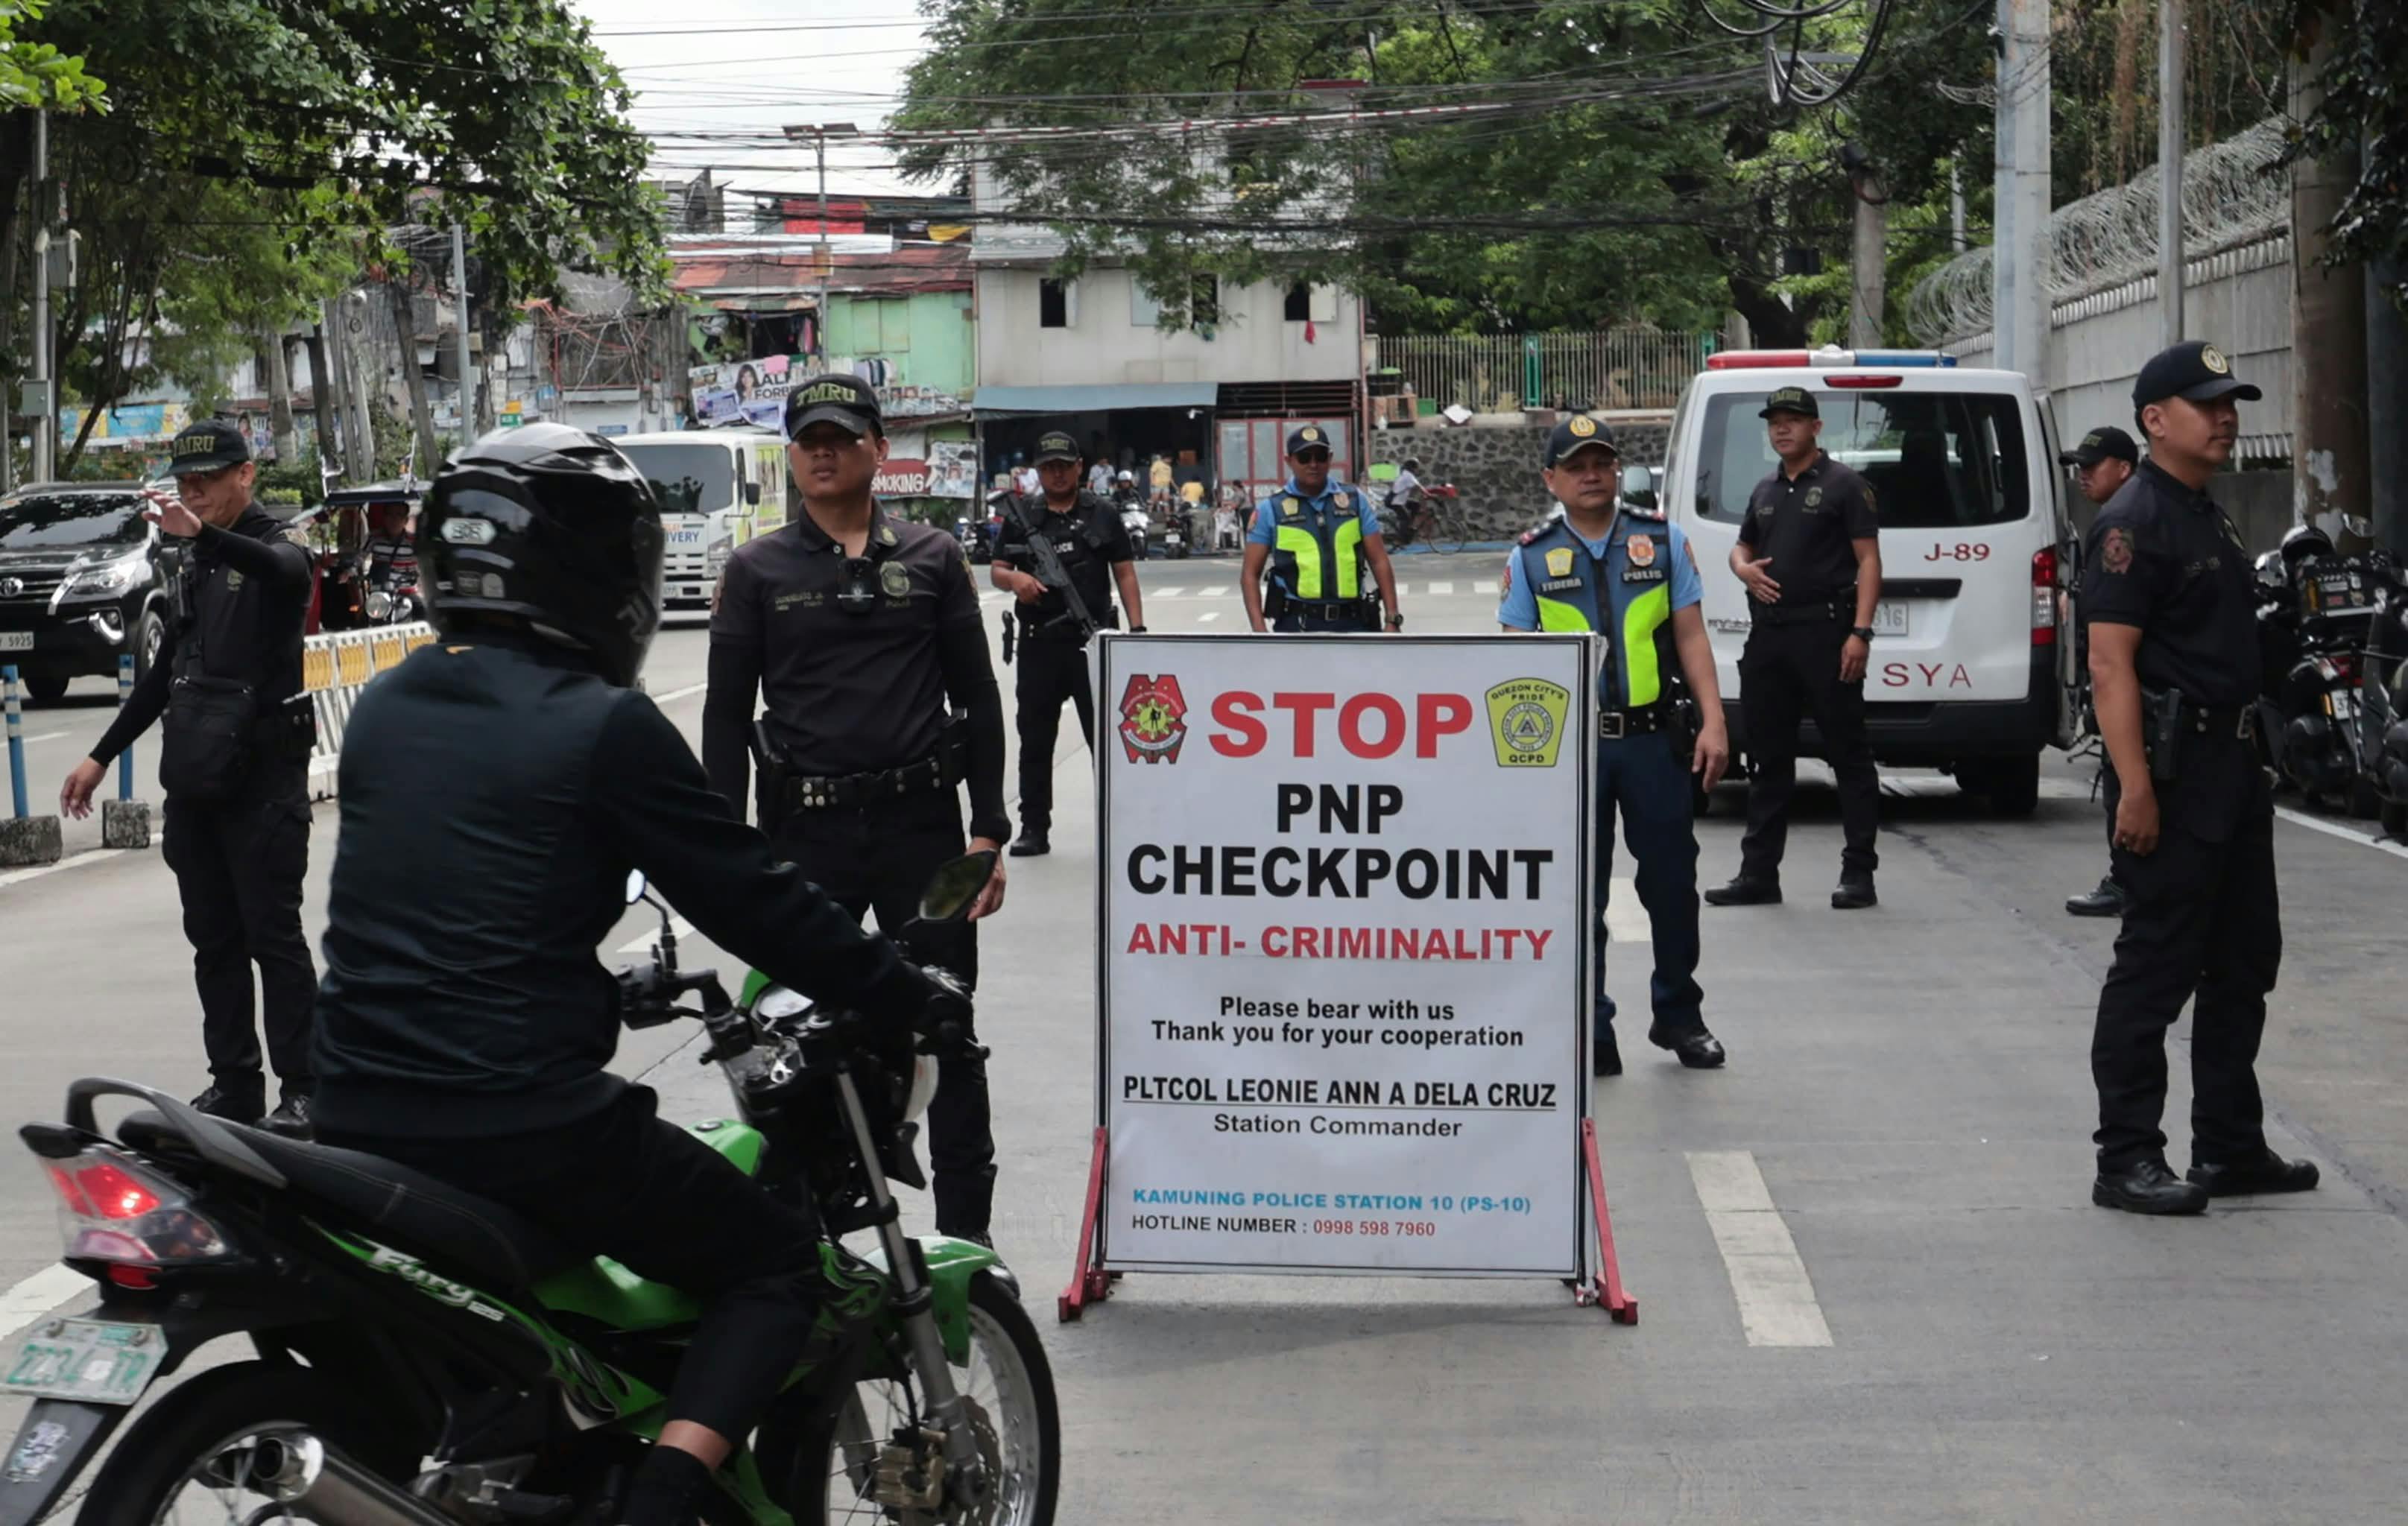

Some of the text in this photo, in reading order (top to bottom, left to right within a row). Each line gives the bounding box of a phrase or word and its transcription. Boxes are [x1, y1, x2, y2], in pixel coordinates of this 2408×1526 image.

[796, 382, 856, 408] TMRU
[1924, 542, 1991, 563] J-89
[1209, 691, 1473, 759] STOP
[1508, 753, 1545, 764] QCPD
[1277, 784, 1403, 834] PNP
[1128, 844, 1553, 900] CHECKPOINT
[1127, 923, 1552, 960] ANTI- CRIMINALITY
[1221, 996, 1453, 1020] Please bear with us
[1151, 1020, 1523, 1049] Thank you for your cooperation
[1125, 1076, 1556, 1106] PLTCOL LEONIE ANN A DELA CRUZ
[1215, 1114, 1462, 1136] Station Commander
[1134, 1190, 1530, 1214] KAMUNING POLICE STATION 10 (PS-10)
[1133, 1215, 1210, 1230] HOTLINE
[1218, 1218, 1295, 1232] NUMBER
[1313, 1220, 1353, 1234] 0998
[1360, 1221, 1388, 1235] 598
[1395, 1222, 1435, 1235] 7960
